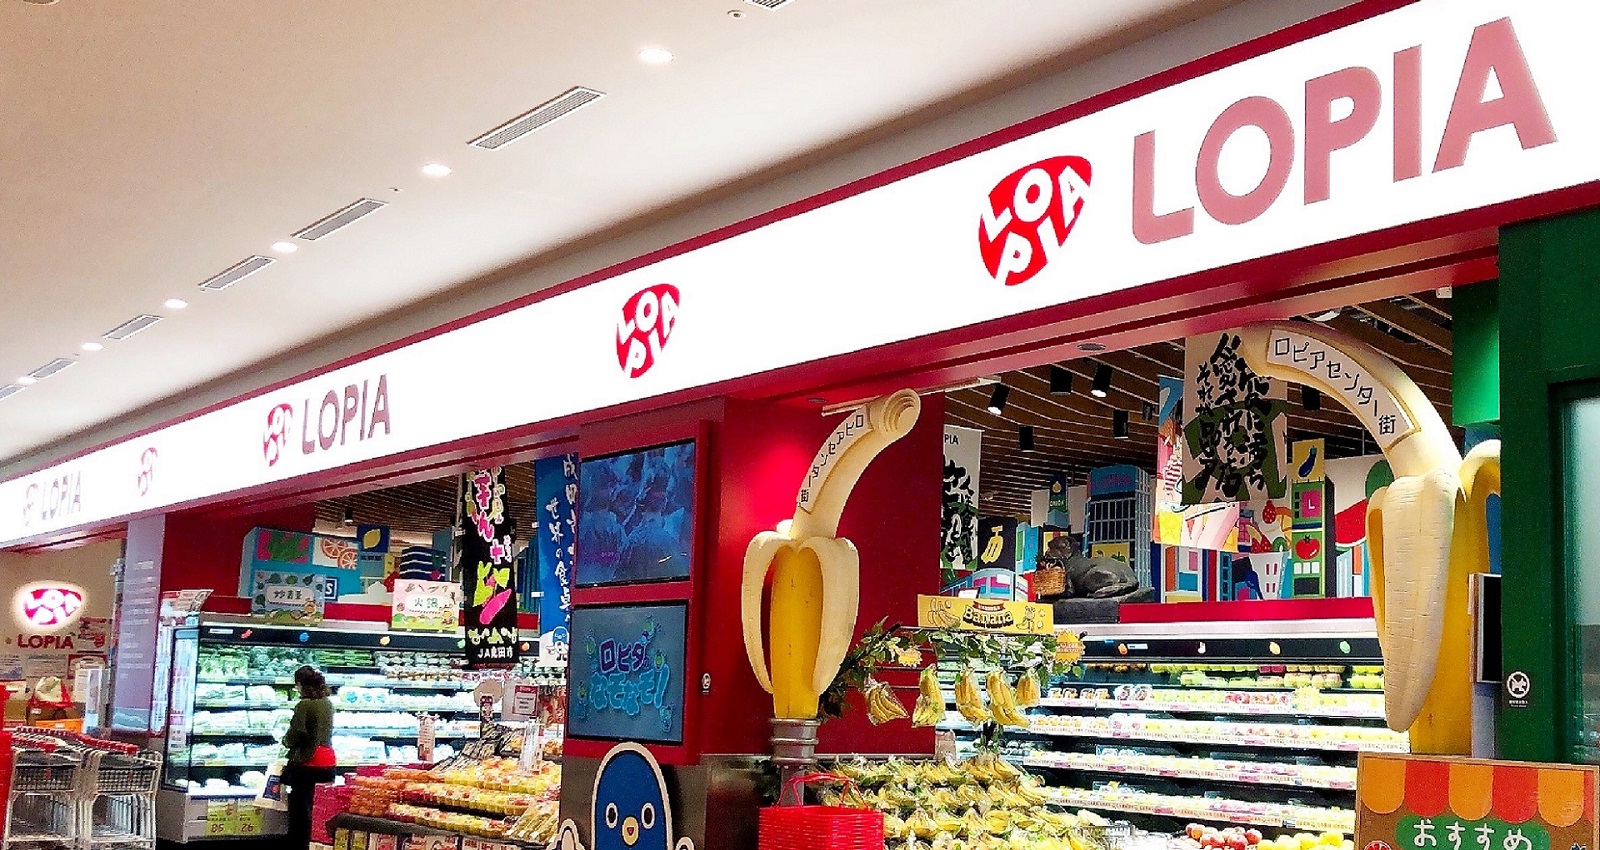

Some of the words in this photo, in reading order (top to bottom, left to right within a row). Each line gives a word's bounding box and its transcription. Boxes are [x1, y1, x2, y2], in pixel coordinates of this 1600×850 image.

[1132, 16, 1557, 244] LOPIA
[302, 373, 391, 455] LOPIA
[1275, 338, 1396, 435] ロピアセンター街
[801, 415, 864, 502] ロピアセンター街
[944, 433, 959, 446] PIA
[18, 634, 73, 649] LOPIA
[963, 605, 1014, 628] Banana
[1414, 819, 1532, 850] おすすめ
